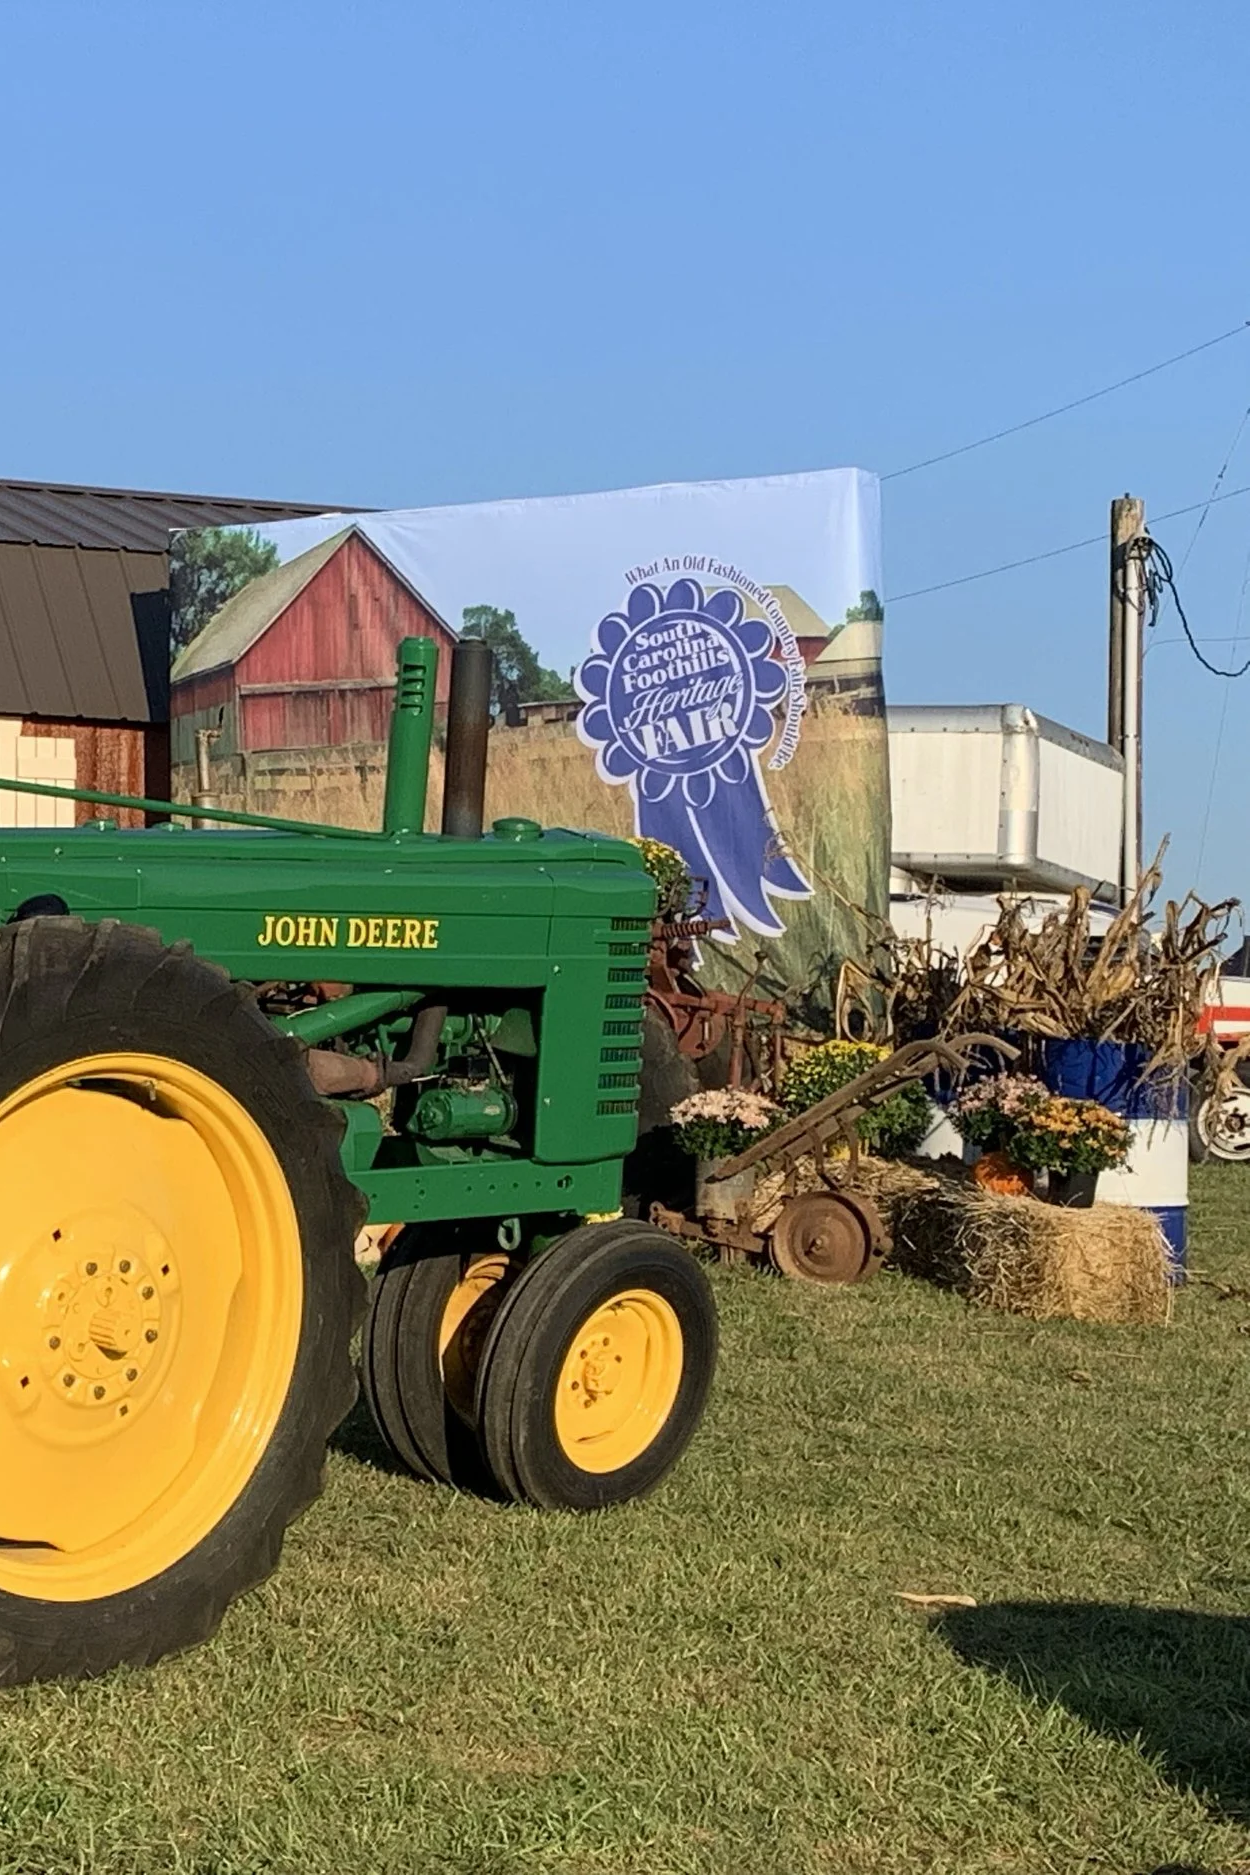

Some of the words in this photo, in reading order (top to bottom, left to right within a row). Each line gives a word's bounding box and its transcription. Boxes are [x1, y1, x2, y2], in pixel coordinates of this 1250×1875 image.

[625, 561, 660, 586] What
[662, 556, 680, 572] An
[683, 554, 706, 571] Old
[707, 557, 770, 604] Fashioned
[635, 620, 702, 651] South
[765, 598, 797, 656] Country
[621, 648, 731, 694] Foothills
[622, 634, 720, 673] Carolina
[790, 657, 805, 694] Fair
[618, 672, 743, 733] Heritage
[639, 702, 739, 761] FAIR
[782, 694, 805, 753] Should
[257, 915, 340, 947] JOHN
[346, 917, 440, 949] DEERE
